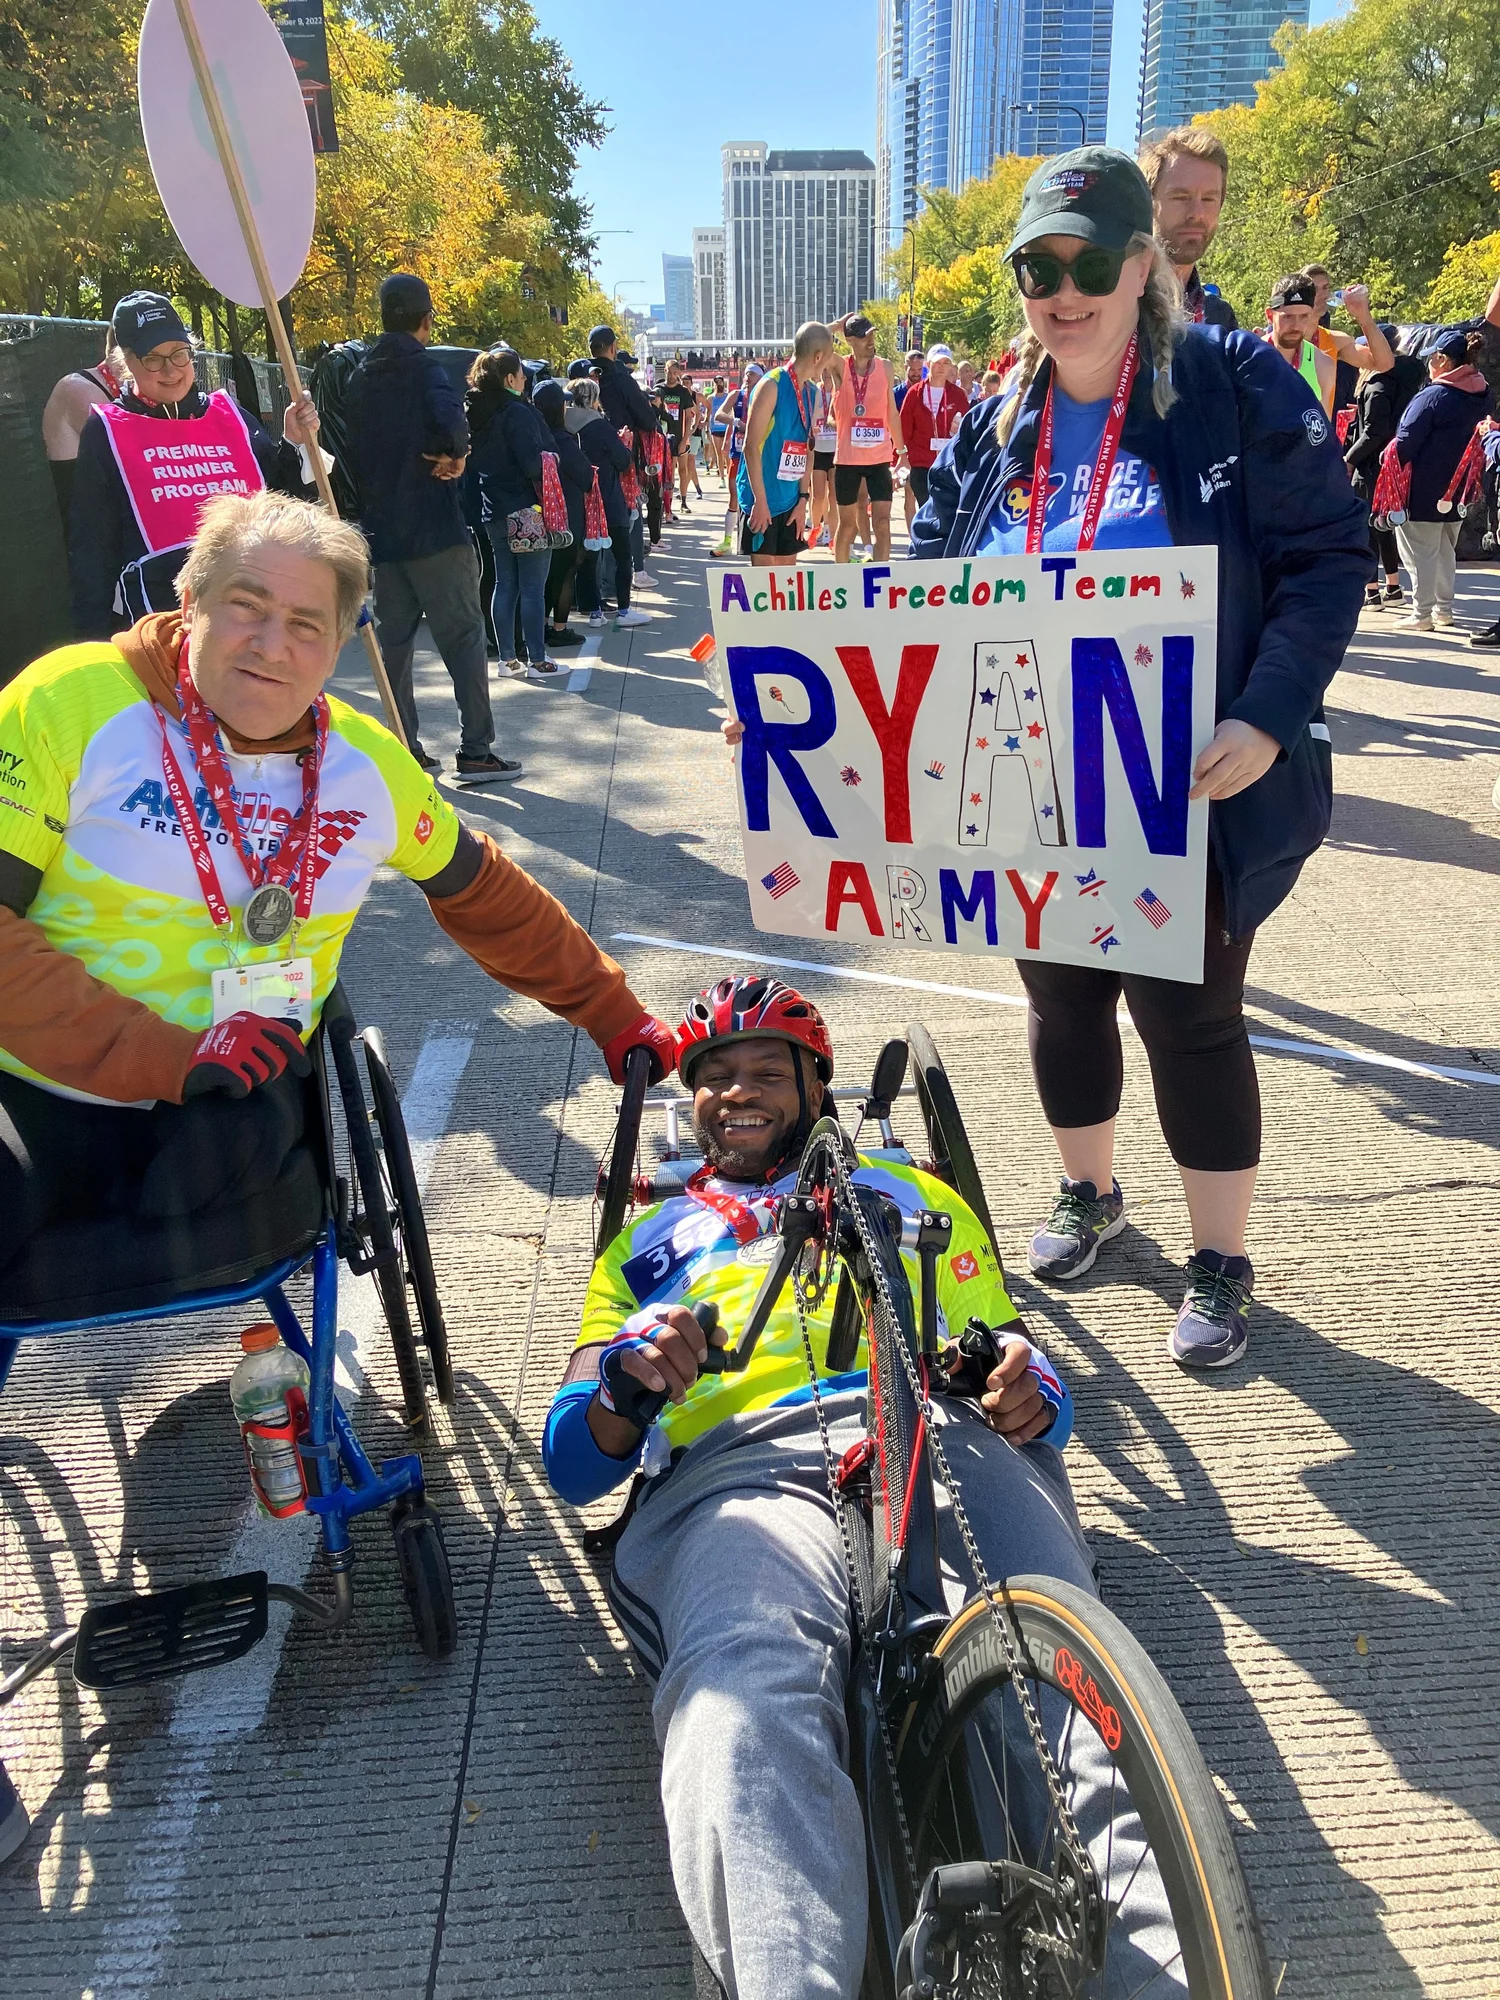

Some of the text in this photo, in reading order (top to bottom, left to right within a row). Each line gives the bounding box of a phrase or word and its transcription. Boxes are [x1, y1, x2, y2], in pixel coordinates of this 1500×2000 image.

[305, 17, 323, 25] 2022
[1127, 346, 1136, 359] OF
[1116, 358, 1132, 398] AMERICA
[855, 428, 881, 438] C 3530
[1311, 419, 1322, 432] 40
[143, 444, 232, 462] PREMIER
[784, 454, 792, 466] B
[152, 461, 238, 480] RUNNER
[1072, 459, 1142, 492] RCE
[1086, 434, 1114, 521] BANK OF AMERICA
[150, 479, 248, 503] PROGRAM
[1035, 484, 1046, 523] AMERICA
[1033, 523, 1041, 535] OF
[720, 557, 1162, 613] Achilles Freedom Team
[726, 635, 1195, 858] RYAN
[170, 783, 182, 797] OF
[0, 796, 36, 818] GMC
[175, 799, 200, 850] AMERICA
[306, 857, 315, 873] OF
[303, 875, 314, 905] BANK
[825, 860, 1060, 950] ARMY
[284, 972, 304, 981] 2022
[646, 1215, 723, 1280] 358
